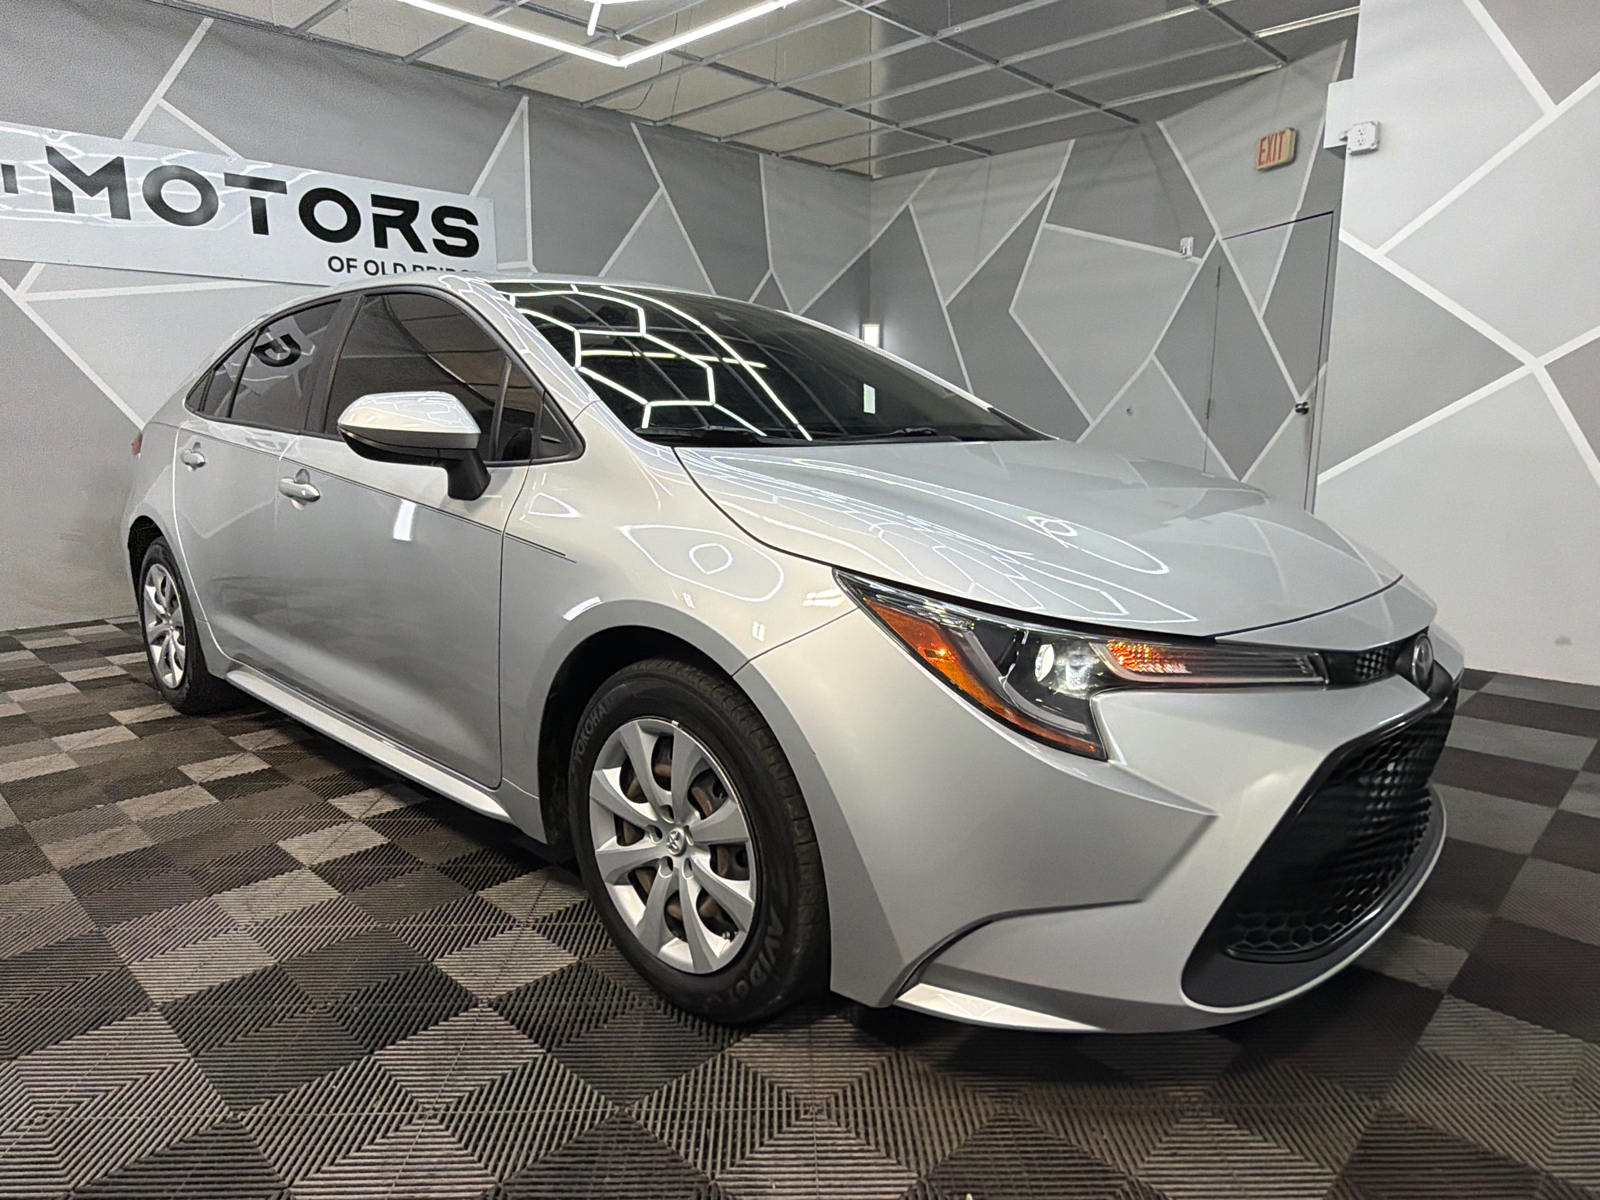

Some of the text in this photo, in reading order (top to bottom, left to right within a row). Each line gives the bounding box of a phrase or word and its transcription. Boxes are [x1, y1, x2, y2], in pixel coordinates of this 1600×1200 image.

[1258, 131, 1285, 166] EXIT
[46, 145, 480, 258] MOTORS
[328, 256, 357, 273] OF
[364, 260, 406, 276] OLD
[573, 695, 617, 764] YOKOHA
